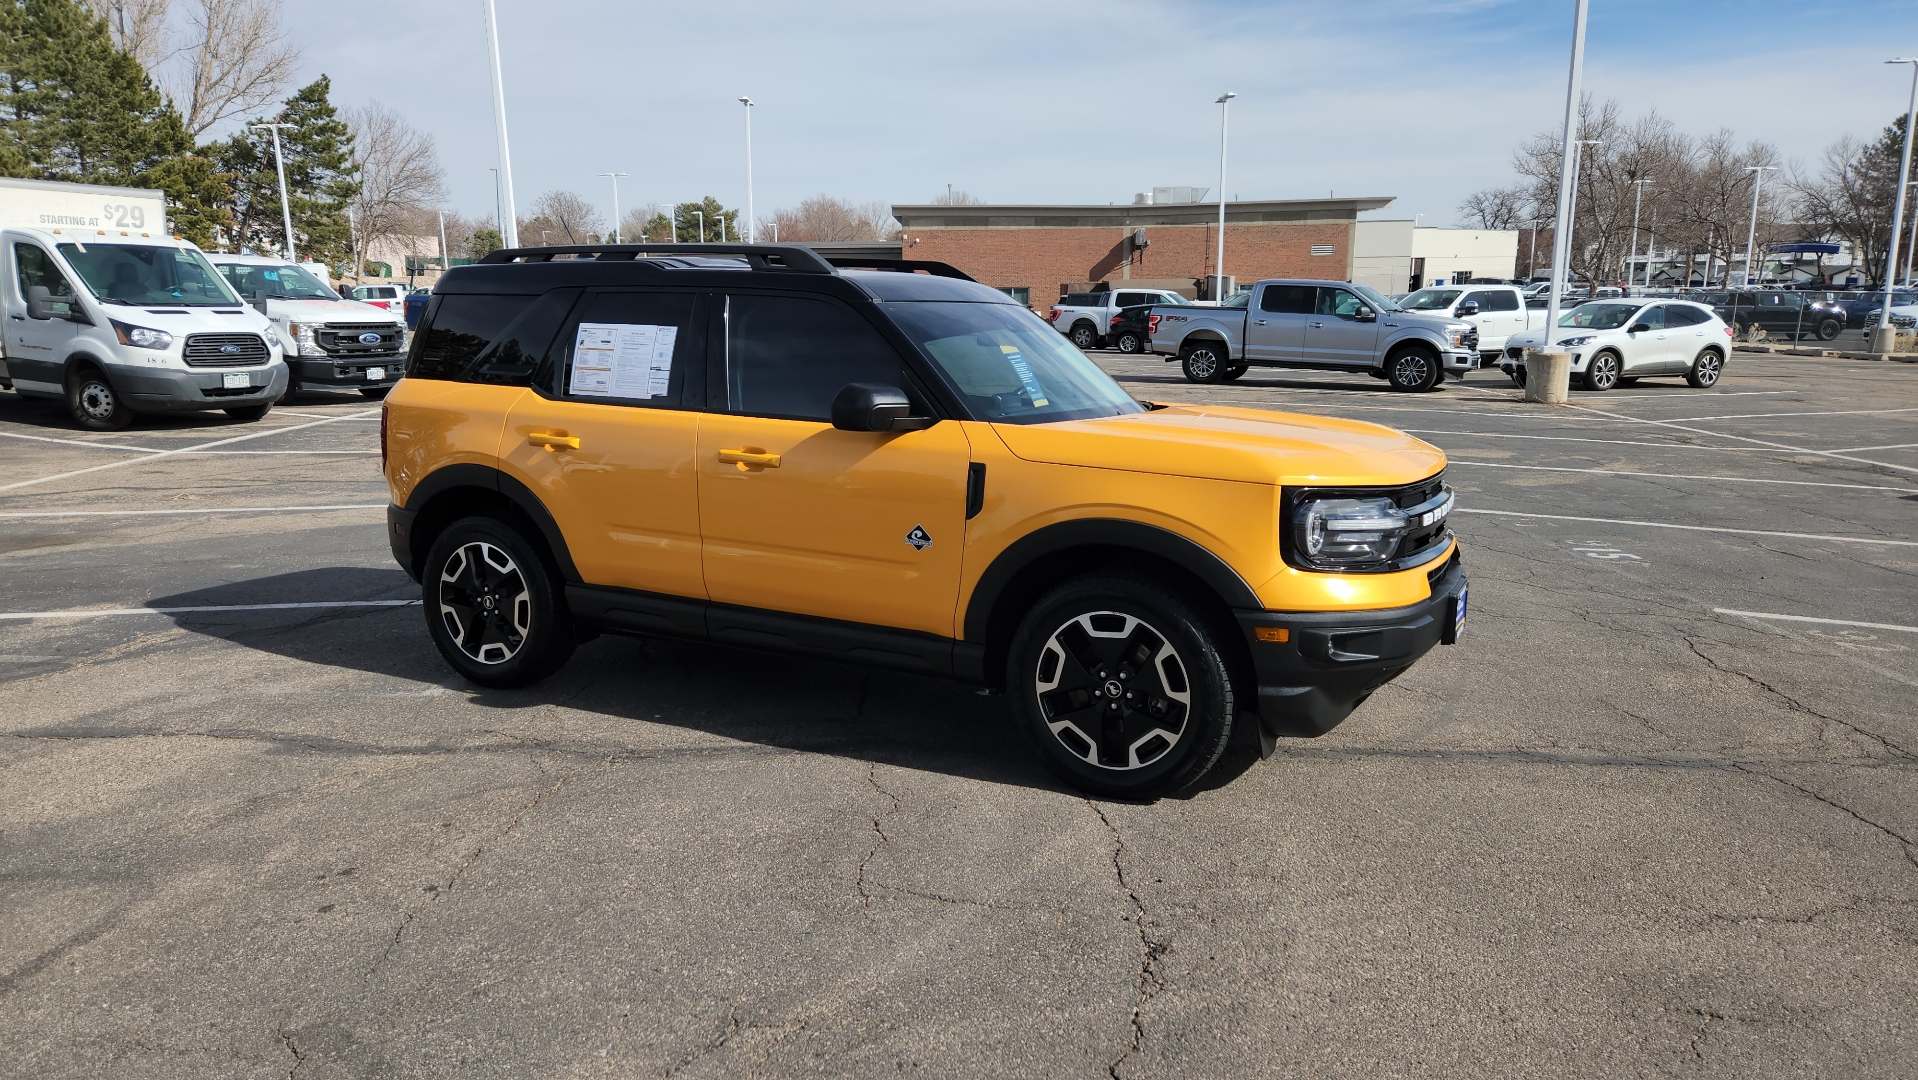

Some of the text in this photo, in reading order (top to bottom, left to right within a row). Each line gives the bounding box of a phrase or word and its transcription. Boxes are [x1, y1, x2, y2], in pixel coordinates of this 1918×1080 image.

[39, 203, 145, 229] STARTING AT $29
